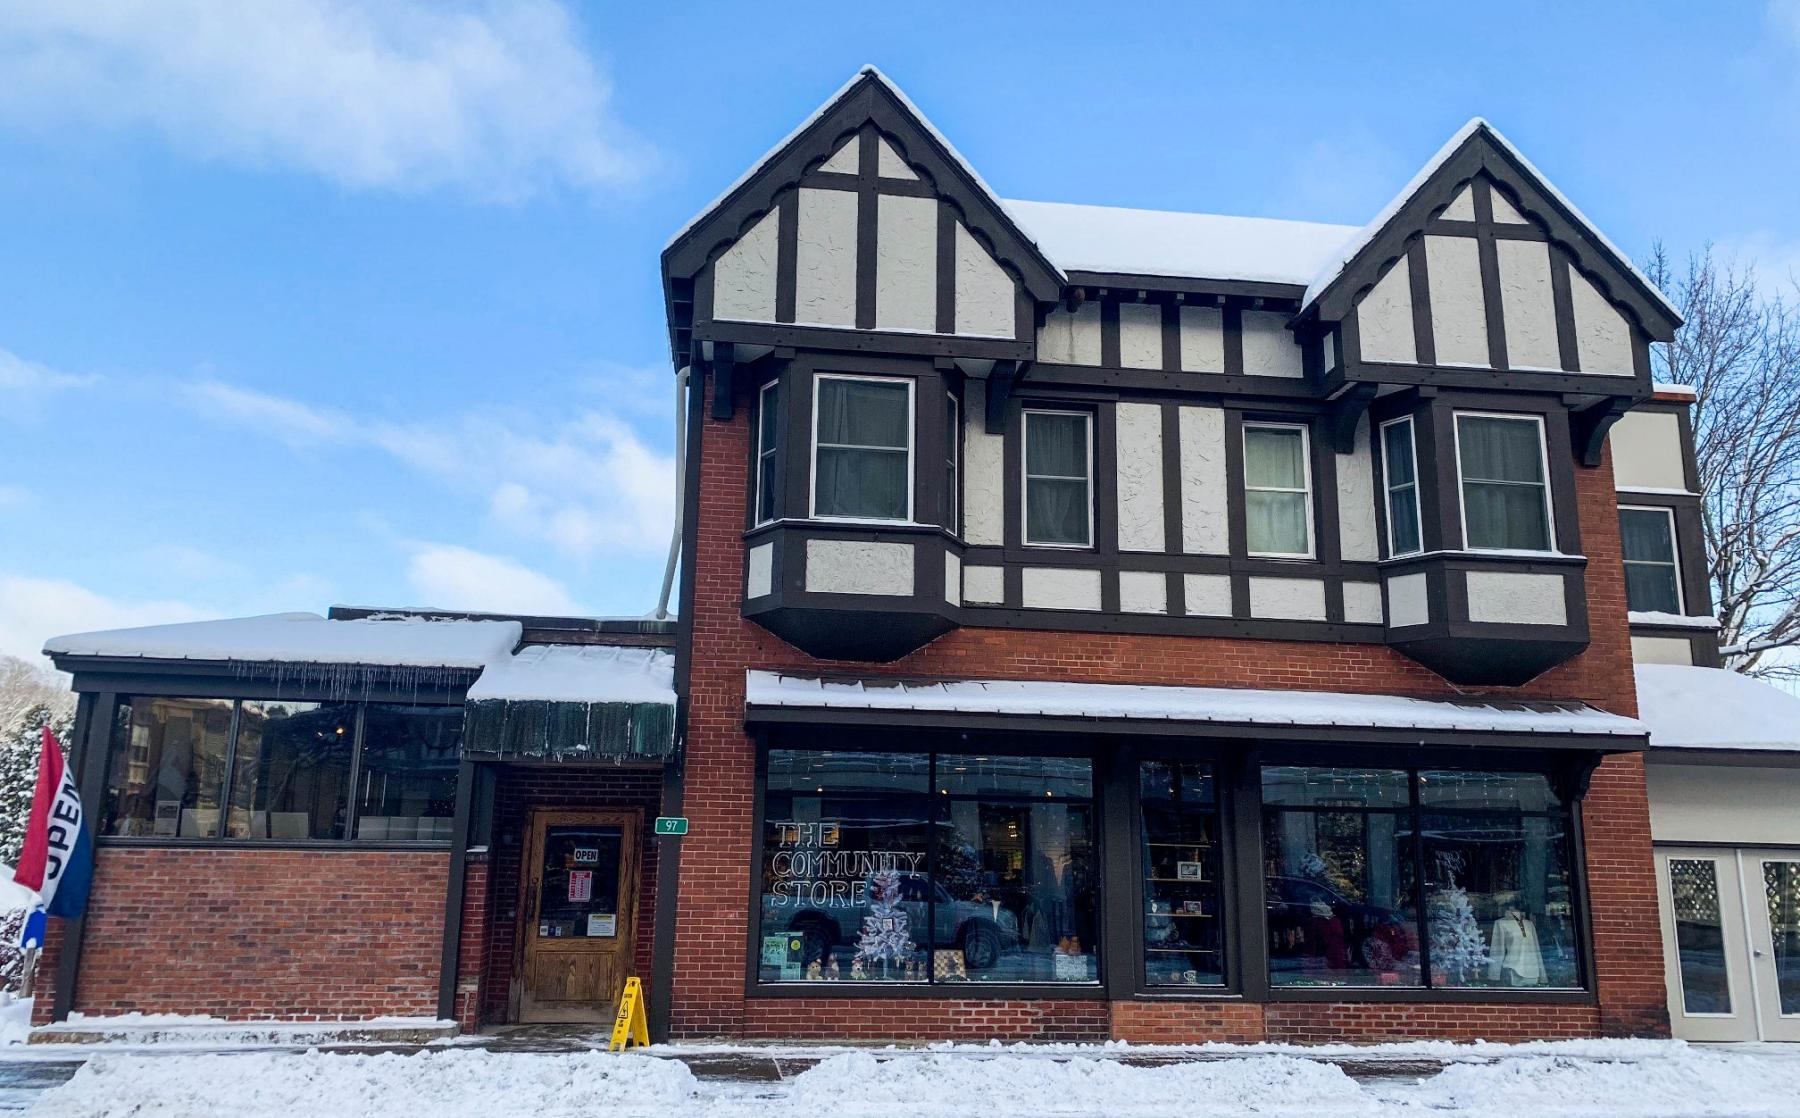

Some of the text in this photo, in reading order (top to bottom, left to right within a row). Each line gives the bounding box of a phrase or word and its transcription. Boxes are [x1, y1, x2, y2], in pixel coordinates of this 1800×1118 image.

[665, 820, 678, 831] 97
[775, 822, 839, 848] THE
[575, 850, 597, 860] OPEN
[772, 850, 925, 879] COMMUNITY
[771, 881, 867, 908] STORE
